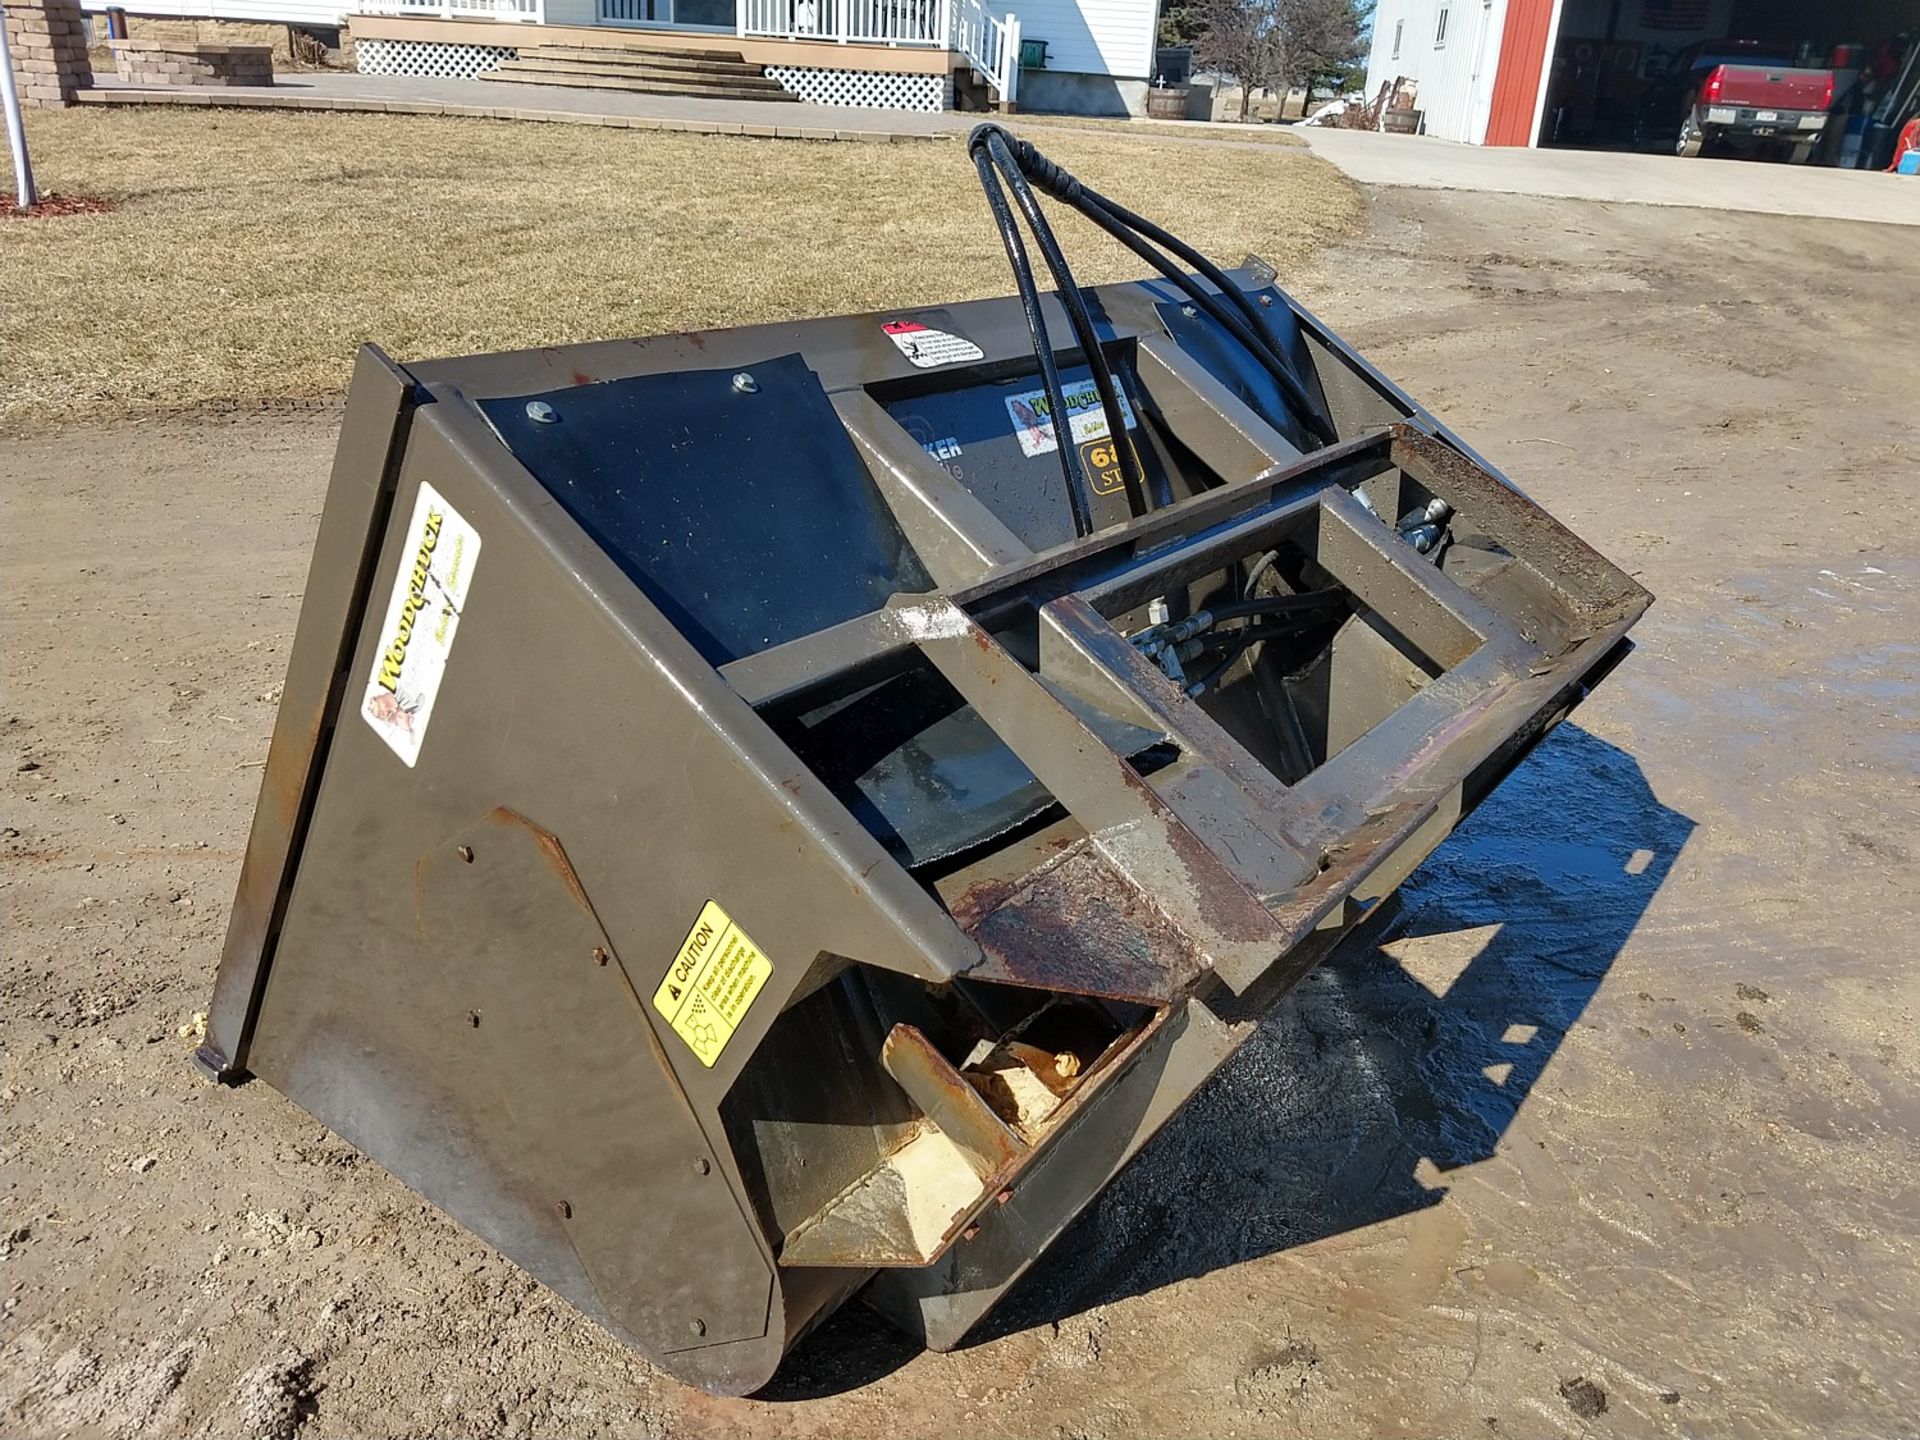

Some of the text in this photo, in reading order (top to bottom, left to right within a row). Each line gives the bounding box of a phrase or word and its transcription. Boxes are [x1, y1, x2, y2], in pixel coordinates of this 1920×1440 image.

[675, 921, 714, 983] CAUTION
[703, 975, 715, 991] Keep
[718, 934, 738, 968] personnel
[711, 984, 722, 1001] clear
[724, 946, 745, 978] discharge
[719, 951, 756, 1010] area when machine
